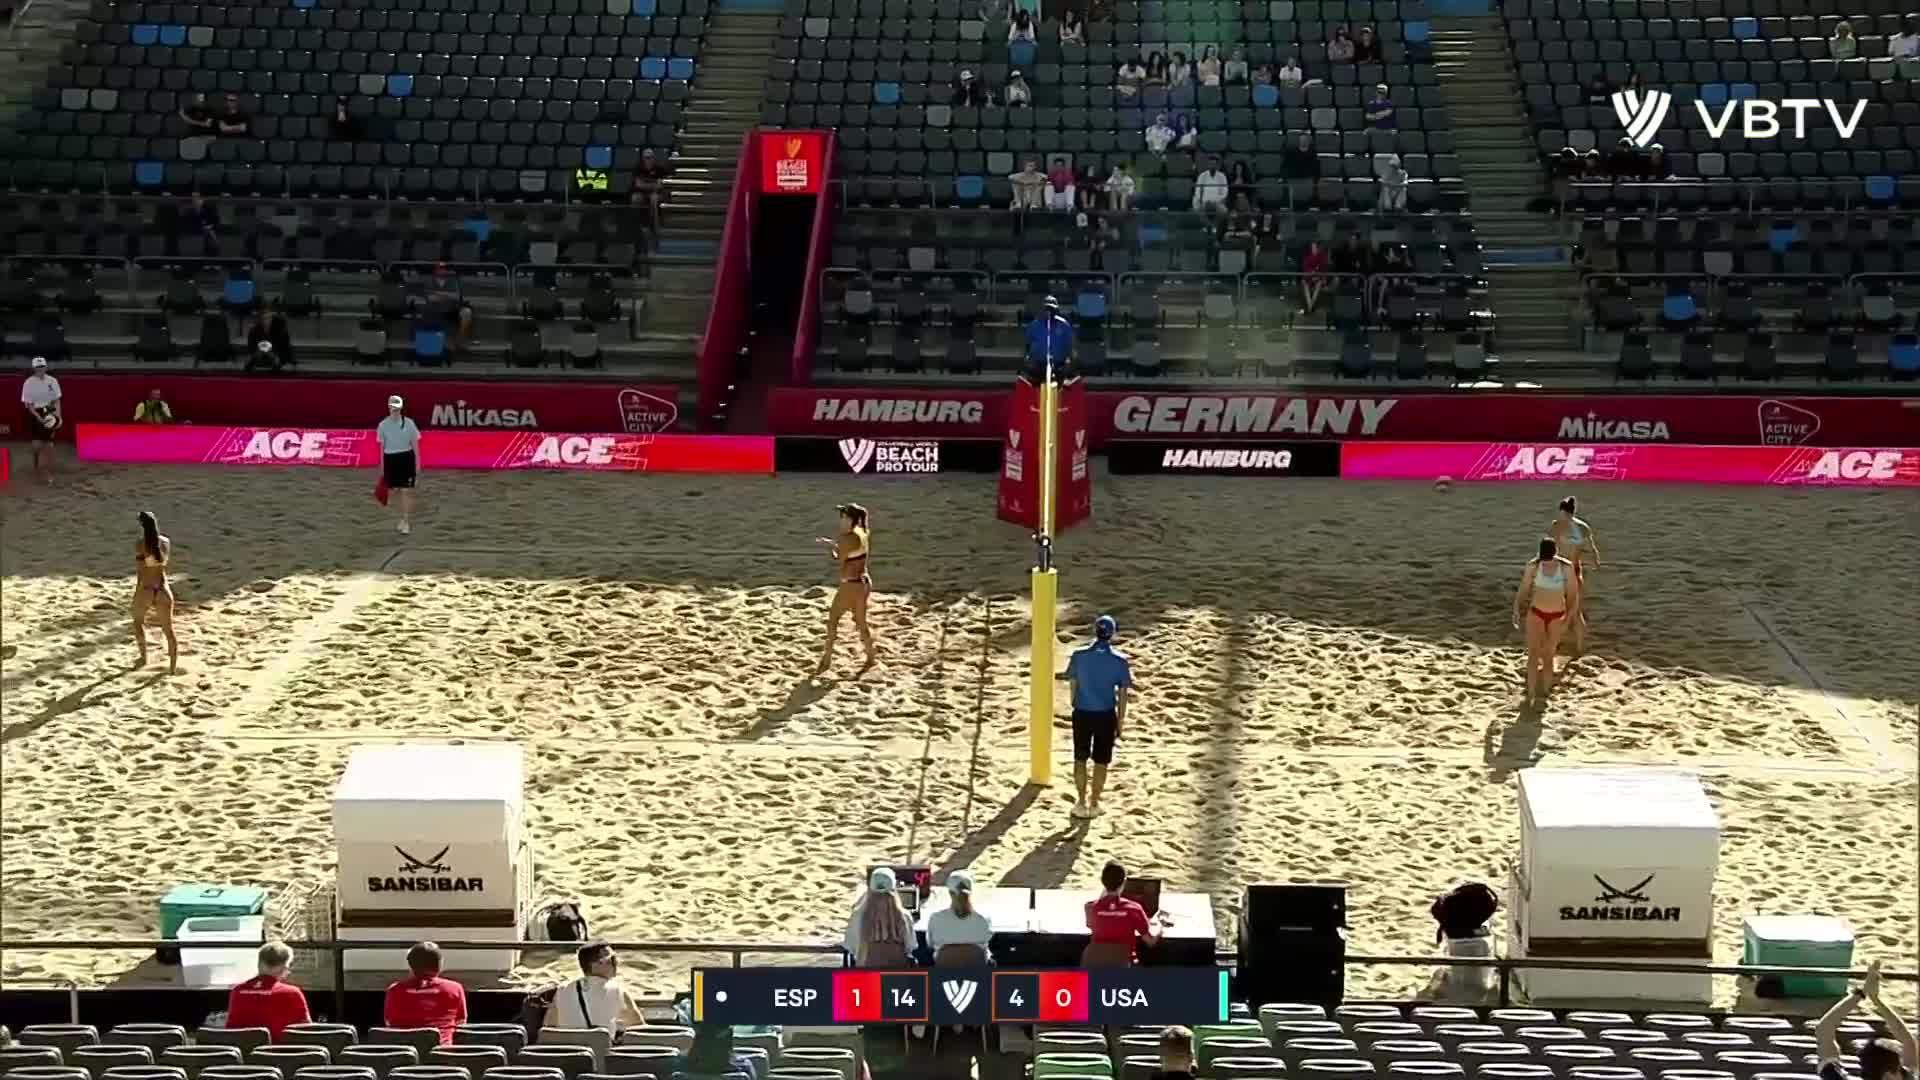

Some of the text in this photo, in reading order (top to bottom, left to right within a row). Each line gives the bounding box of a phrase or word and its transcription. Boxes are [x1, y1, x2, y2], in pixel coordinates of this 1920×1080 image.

[627, 412, 667, 422] ACTIVE
[813, 399, 984, 423] HAMBURG
[1114, 396, 1399, 434] GERMANY
[629, 423, 653, 432] CITY
[1766, 424, 1808, 434] ACTIVE
[242, 431, 328, 459] ACE
[1767, 434, 1793, 444] CITY
[532, 436, 615, 464] ACE
[876, 447, 939, 461] BEACH
[876, 461, 939, 472] PRO TOUR
[1162, 449, 1292, 469] HAMBURG
[1504, 447, 1595, 475] ACE
[1808, 451, 1902, 479] ACE
[368, 877, 484, 892] SANSIBAR
[1559, 906, 1680, 921] SANSIBAR
